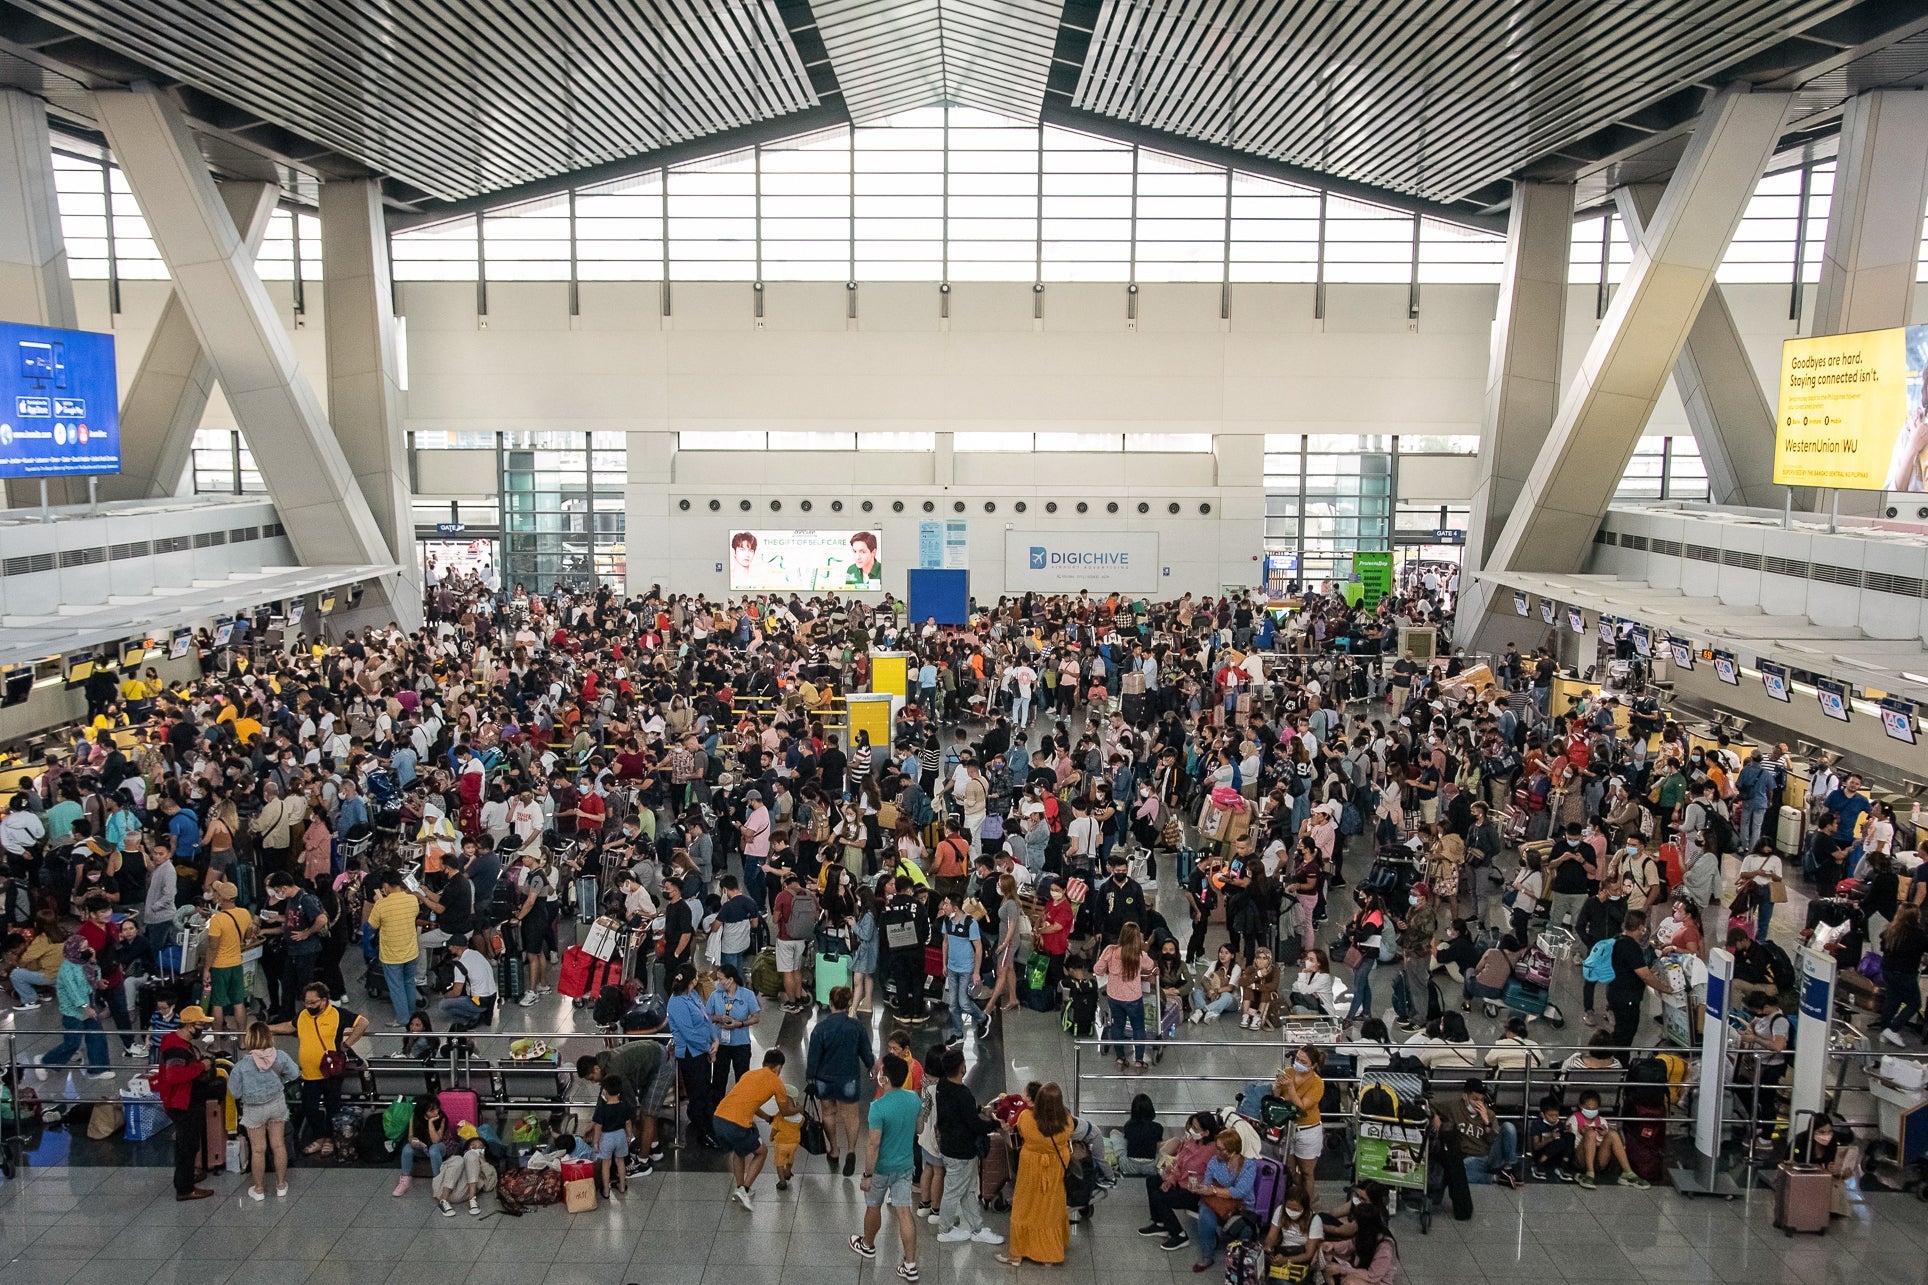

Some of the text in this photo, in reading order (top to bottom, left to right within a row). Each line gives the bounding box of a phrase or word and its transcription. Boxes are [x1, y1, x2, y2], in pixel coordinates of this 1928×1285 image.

[1791, 350, 1863, 371] Goodbyes are hard.
[1790, 367, 1879, 389] Staying connected isn't.
[1785, 438, 1858, 454] WesternUnion WU
[1051, 552, 1129, 564] DIGICHIVE
